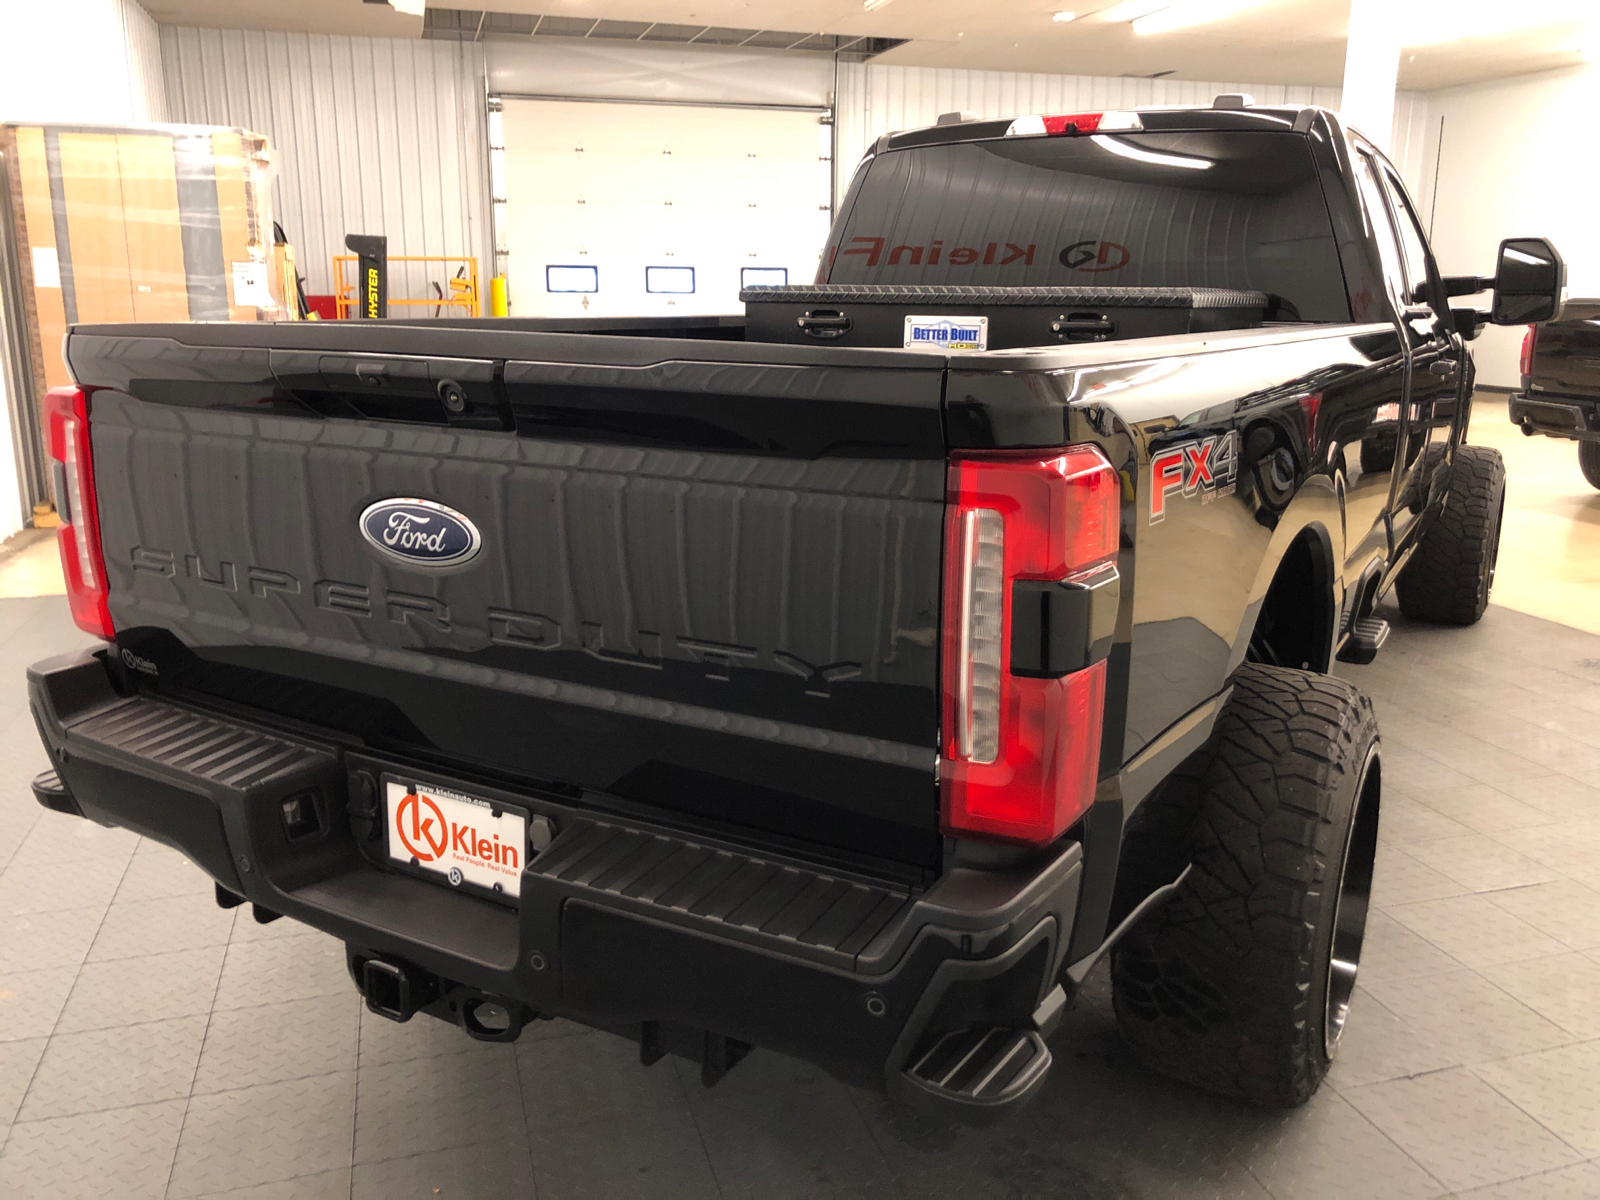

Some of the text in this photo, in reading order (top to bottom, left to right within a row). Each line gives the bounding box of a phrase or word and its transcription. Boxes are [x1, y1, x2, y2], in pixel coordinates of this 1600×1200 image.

[368, 268, 379, 319] HYSTER
[913, 327, 979, 342] BETTER BUILT
[1148, 429, 1238, 527] FX4
[382, 511, 447, 553] Ford
[130, 545, 863, 699] SUPER DUTY
[414, 783, 492, 808] www.kleinauto.com
[452, 822, 519, 869] Klein
